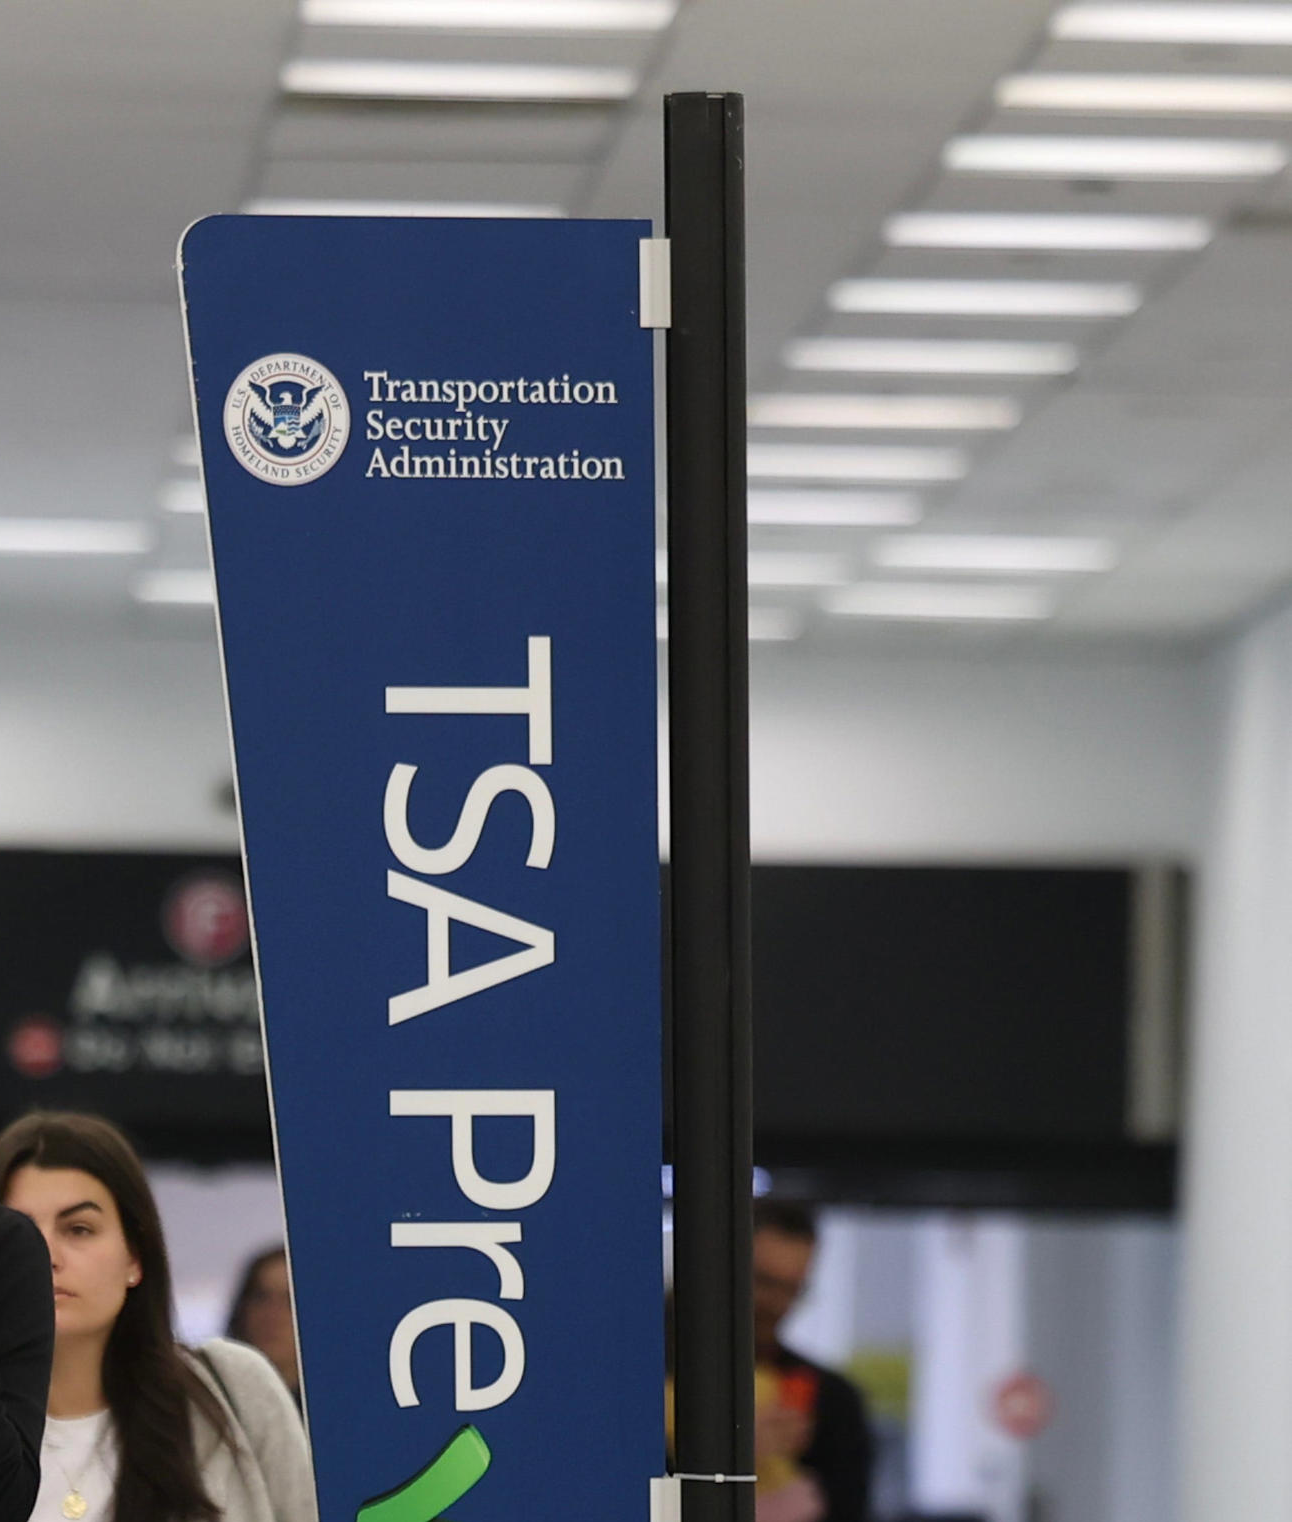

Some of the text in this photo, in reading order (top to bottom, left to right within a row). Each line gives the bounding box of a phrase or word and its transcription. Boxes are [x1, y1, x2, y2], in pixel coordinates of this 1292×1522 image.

[250, 360, 334, 393] DEPARTMENT
[329, 393, 343, 411] OF
[364, 371, 618, 410] Transportation
[231, 424, 343, 479] HOMELAND SECURITY
[366, 410, 509, 450] Security
[365, 447, 625, 480] Administration
[383, 636, 556, 1026] TSA
[389, 1090, 556, 1412] Pre
